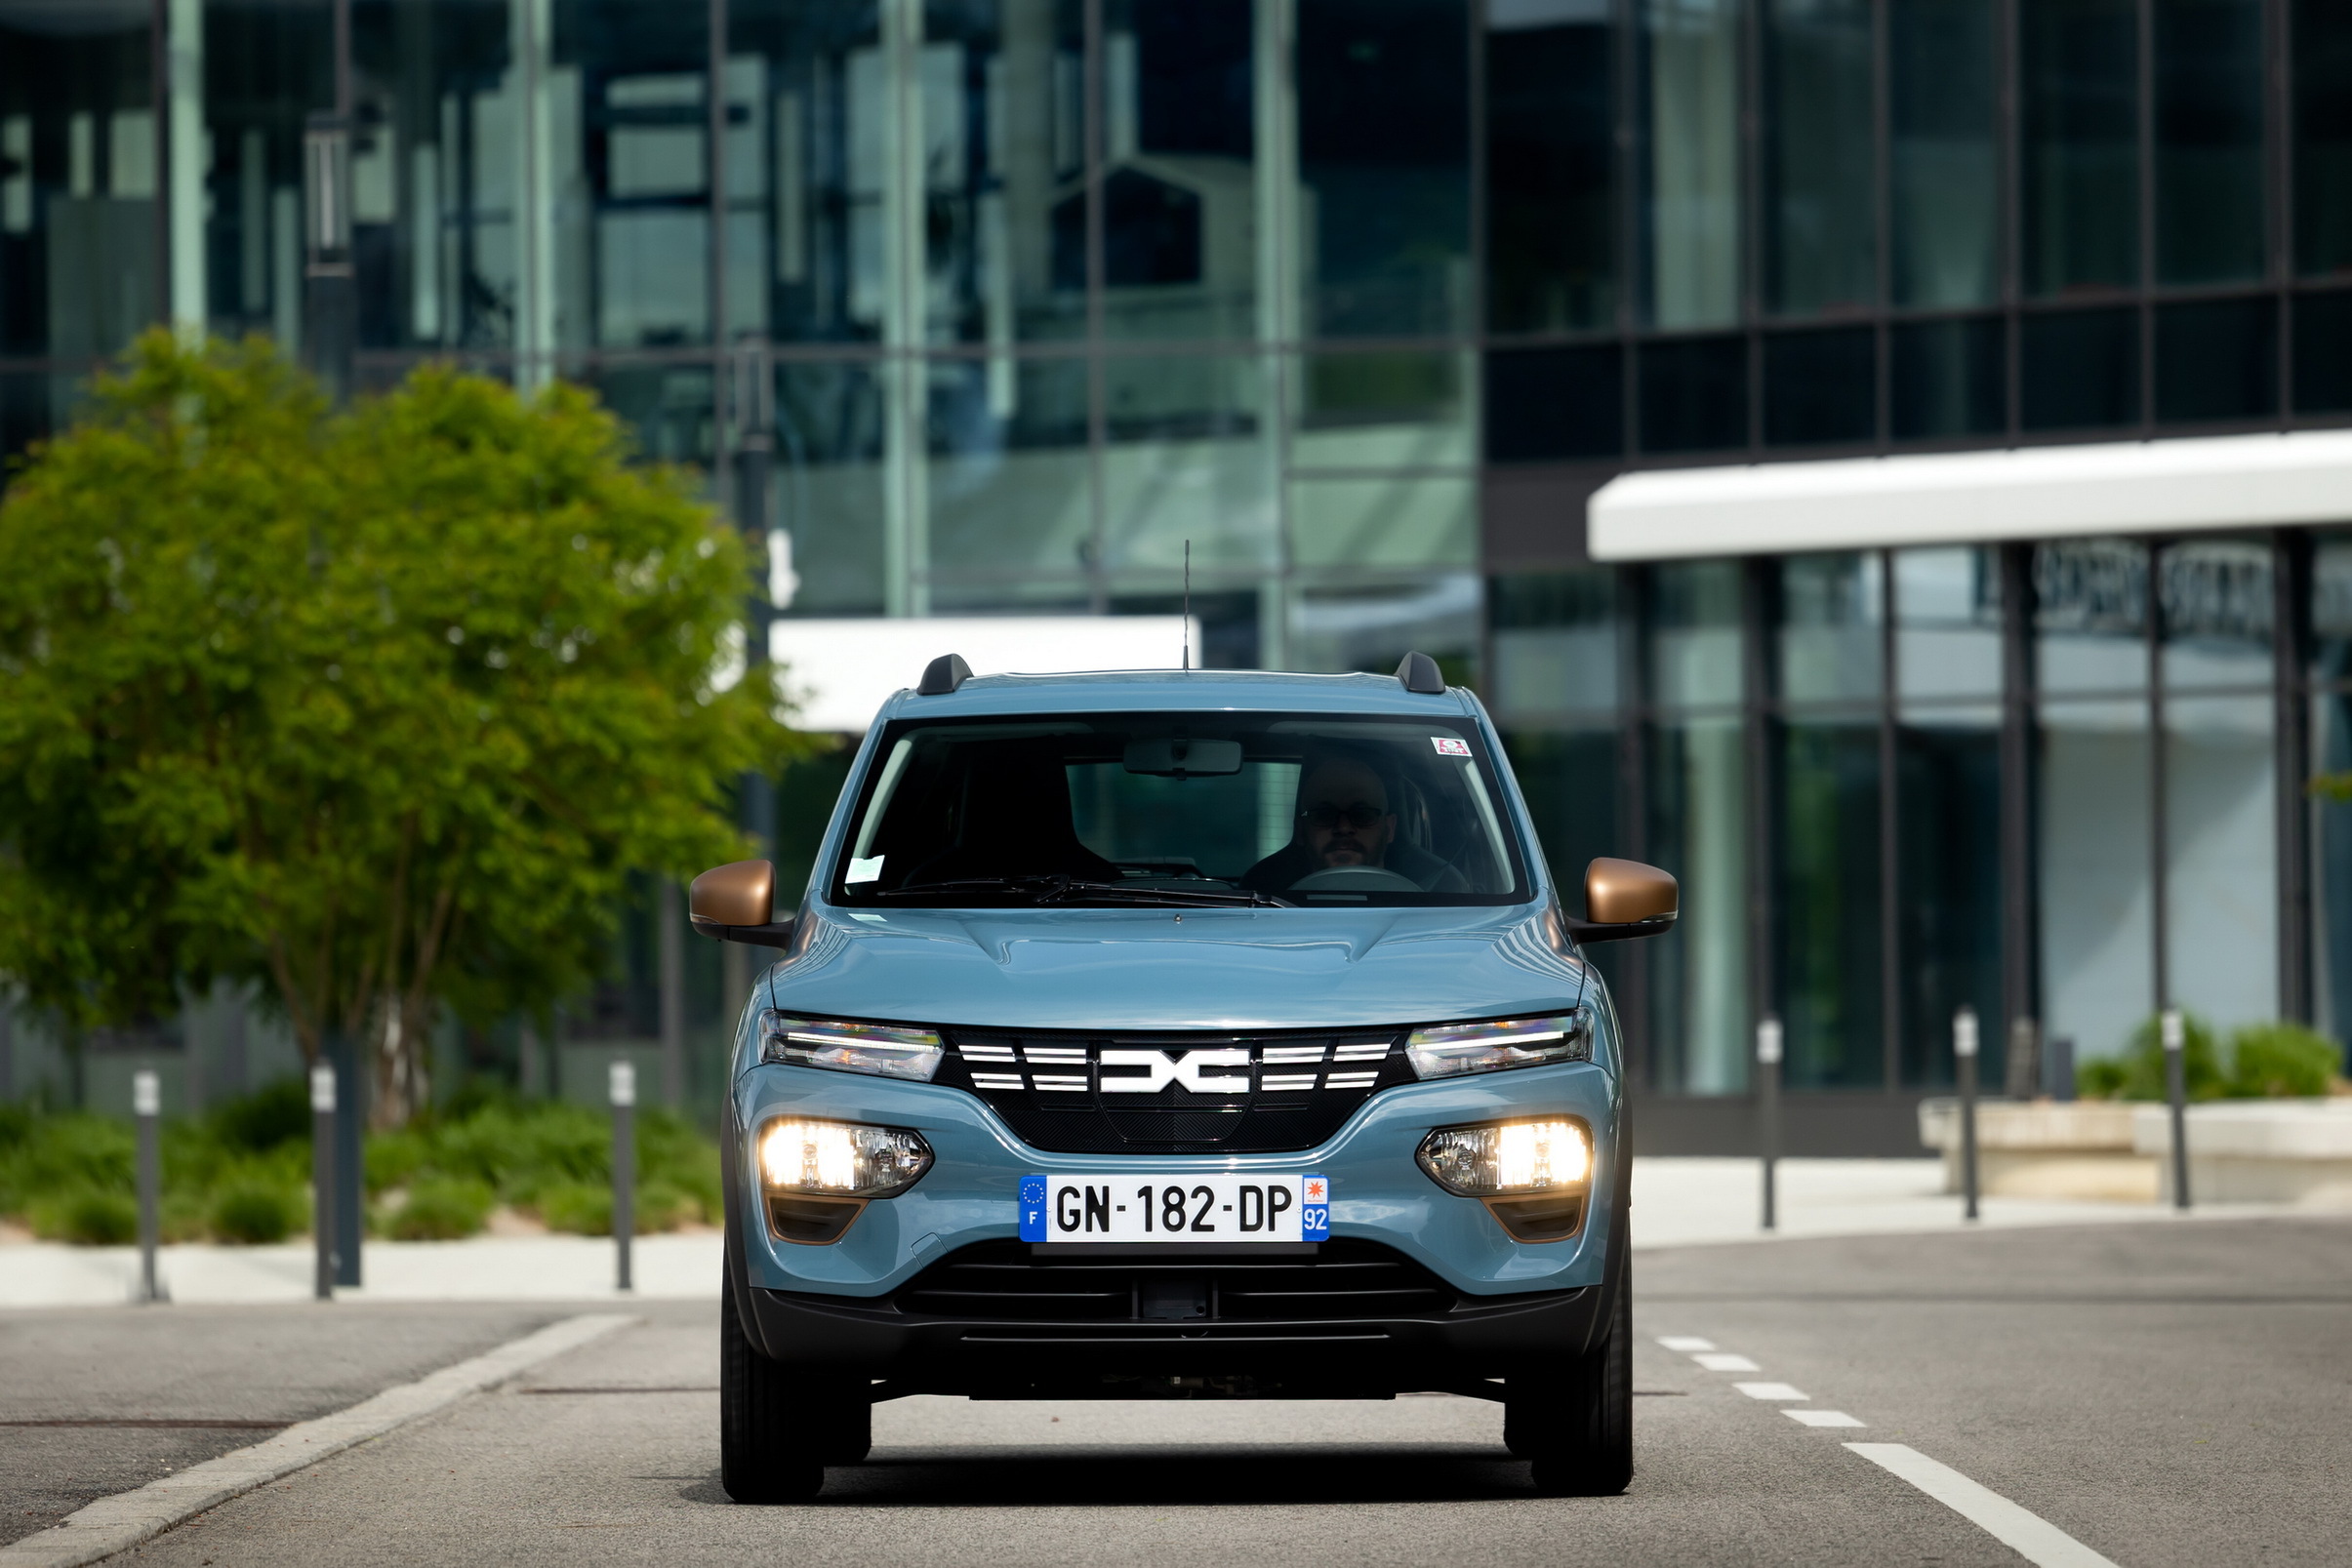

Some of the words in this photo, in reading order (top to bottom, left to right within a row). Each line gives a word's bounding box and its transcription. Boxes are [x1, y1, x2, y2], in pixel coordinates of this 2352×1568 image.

[1029, 1211, 1038, 1225] F
[1056, 1185, 1292, 1232] GN-182-DP
[1304, 1208, 1327, 1230] 92
